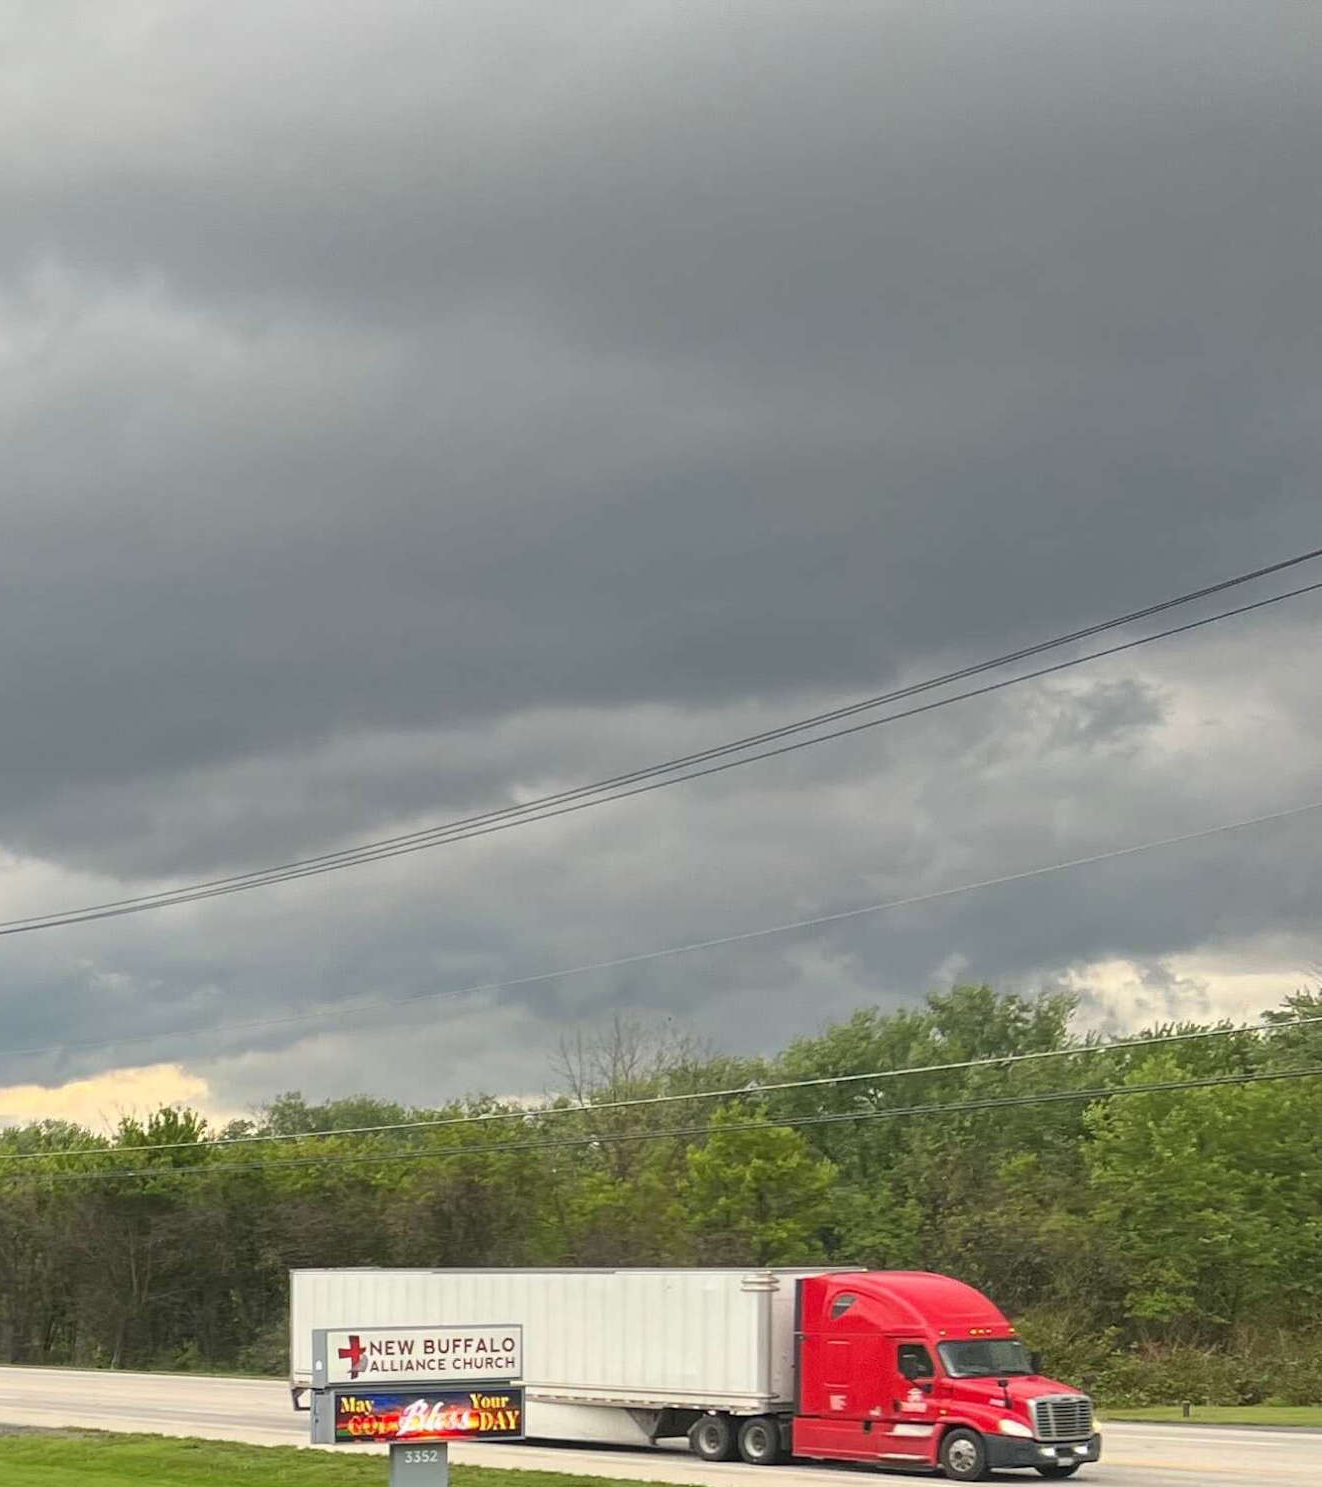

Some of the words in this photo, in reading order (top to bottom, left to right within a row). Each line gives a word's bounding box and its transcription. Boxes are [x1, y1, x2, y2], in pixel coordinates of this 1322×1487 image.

[369, 1340, 414, 1356] NEW
[423, 1338, 515, 1354] BUFFALO
[369, 1358, 446, 1372] ALLIANCE
[452, 1356, 515, 1370] CHURCH
[340, 1397, 374, 1415] May
[470, 1393, 509, 1409] Your
[478, 1410, 519, 1432] DAY
[404, 1450, 438, 1463] 3352
